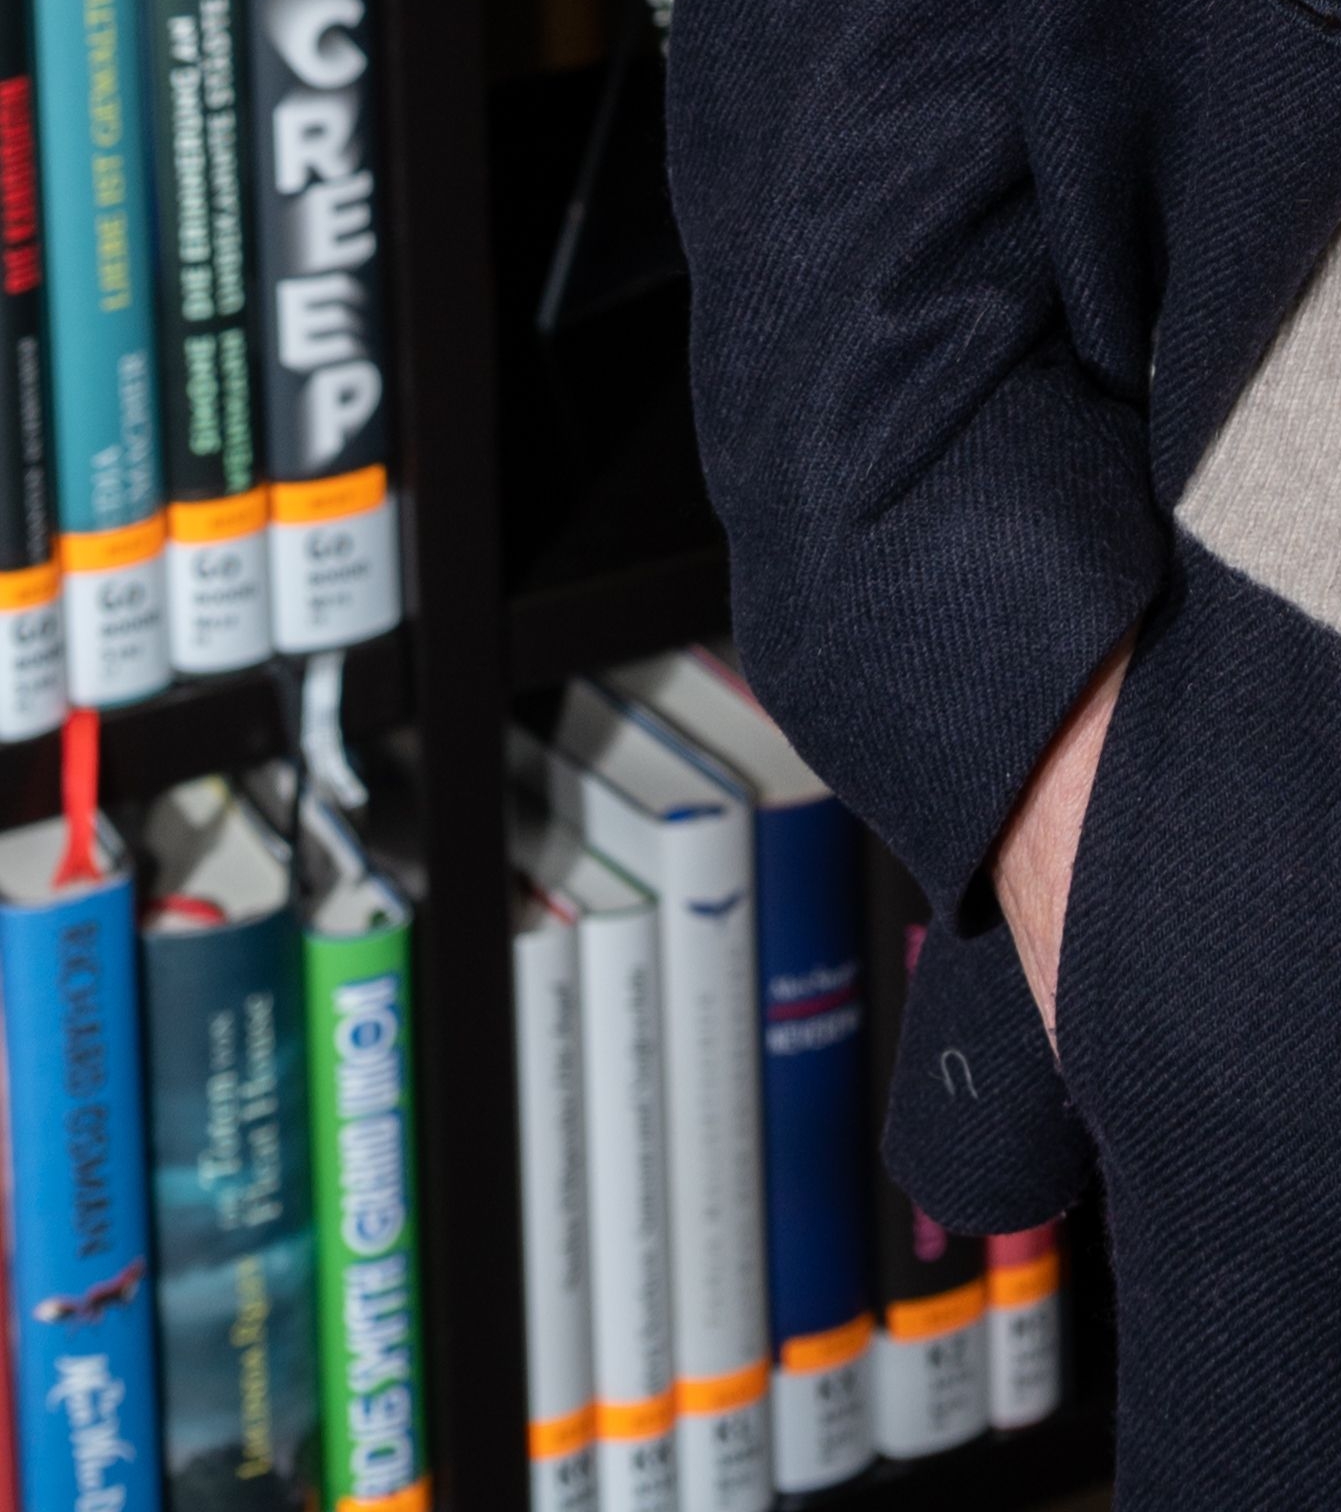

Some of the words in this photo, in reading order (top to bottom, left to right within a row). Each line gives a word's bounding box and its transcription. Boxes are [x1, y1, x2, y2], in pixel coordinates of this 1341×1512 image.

[93, 153, 126, 206] IST
[170, 66, 211, 263] ERINNERUNG
[99, 212, 133, 313] LIEBE
[185, 335, 221, 457] SIMONE
[58, 922, 109, 1099] RICHARD
[330, 971, 402, 1119] UNION
[66, 1103, 113, 1261] OSMAN
[337, 1114, 407, 1256] GRAND
[341, 1253, 411, 1394] SMITH
